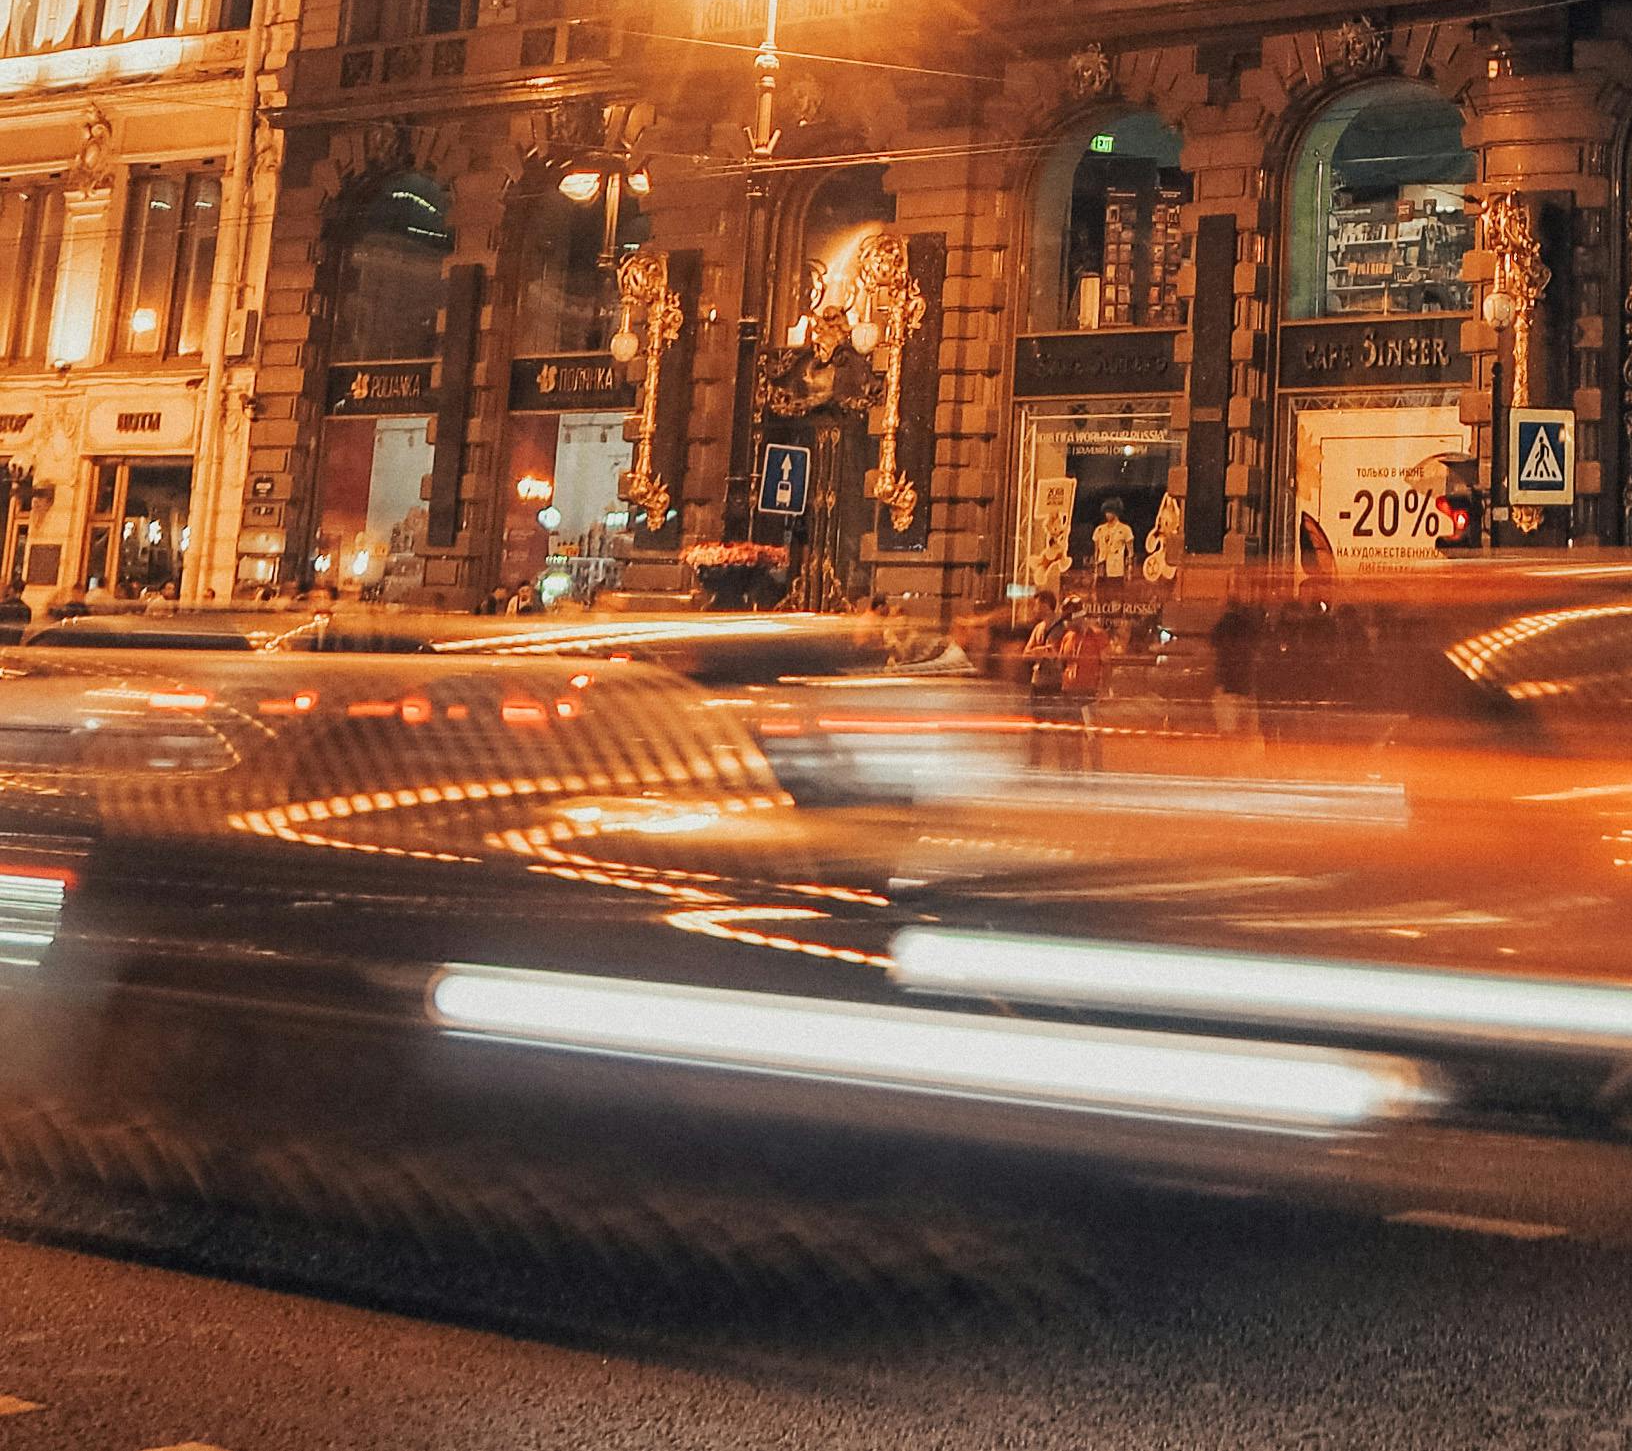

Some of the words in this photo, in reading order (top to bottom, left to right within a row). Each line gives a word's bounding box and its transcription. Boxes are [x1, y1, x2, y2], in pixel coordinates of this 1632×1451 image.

[1356, 467, 1389, 478] ТОЛЬКО
[1391, 468, 1397, 478] В
[1339, 488, 1440, 537] -20%
[1336, 547, 1349, 558] НА
[1350, 546, 1440, 559] ХУДОЖЕСТВЕННУЮ
